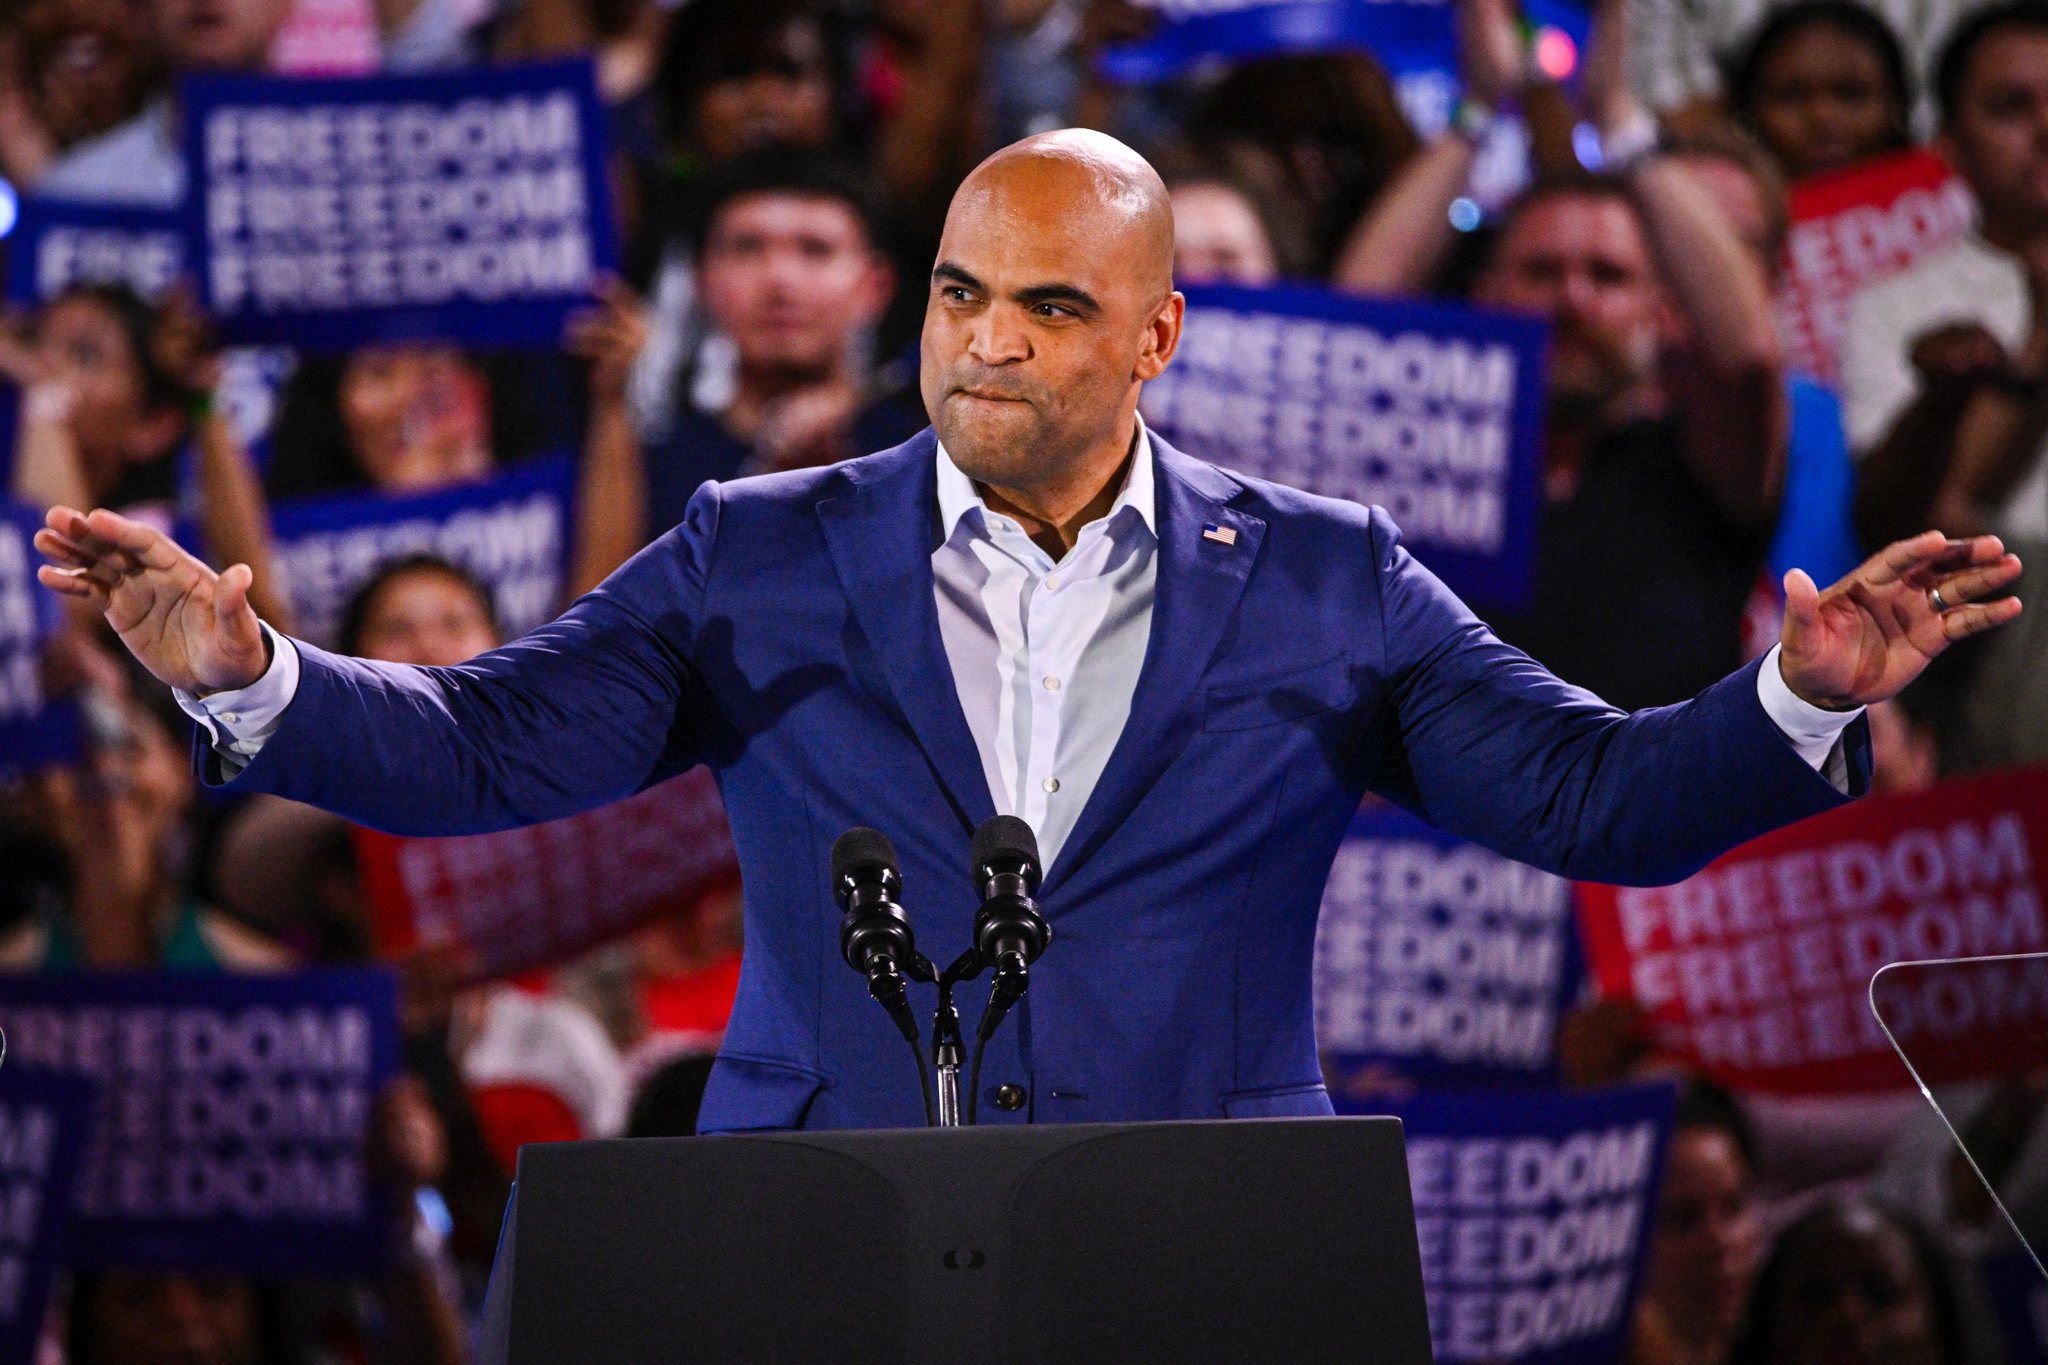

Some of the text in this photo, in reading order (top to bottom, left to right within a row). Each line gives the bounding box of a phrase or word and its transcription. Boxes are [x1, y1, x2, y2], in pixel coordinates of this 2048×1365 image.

[208, 92, 581, 168] FREEDOM
[209, 168, 588, 238] FREEDOM
[211, 236, 593, 310] FREEDOM
[1618, 812, 2030, 951] FREEDOM
[1630, 887, 2044, 1014] FREEDOM
